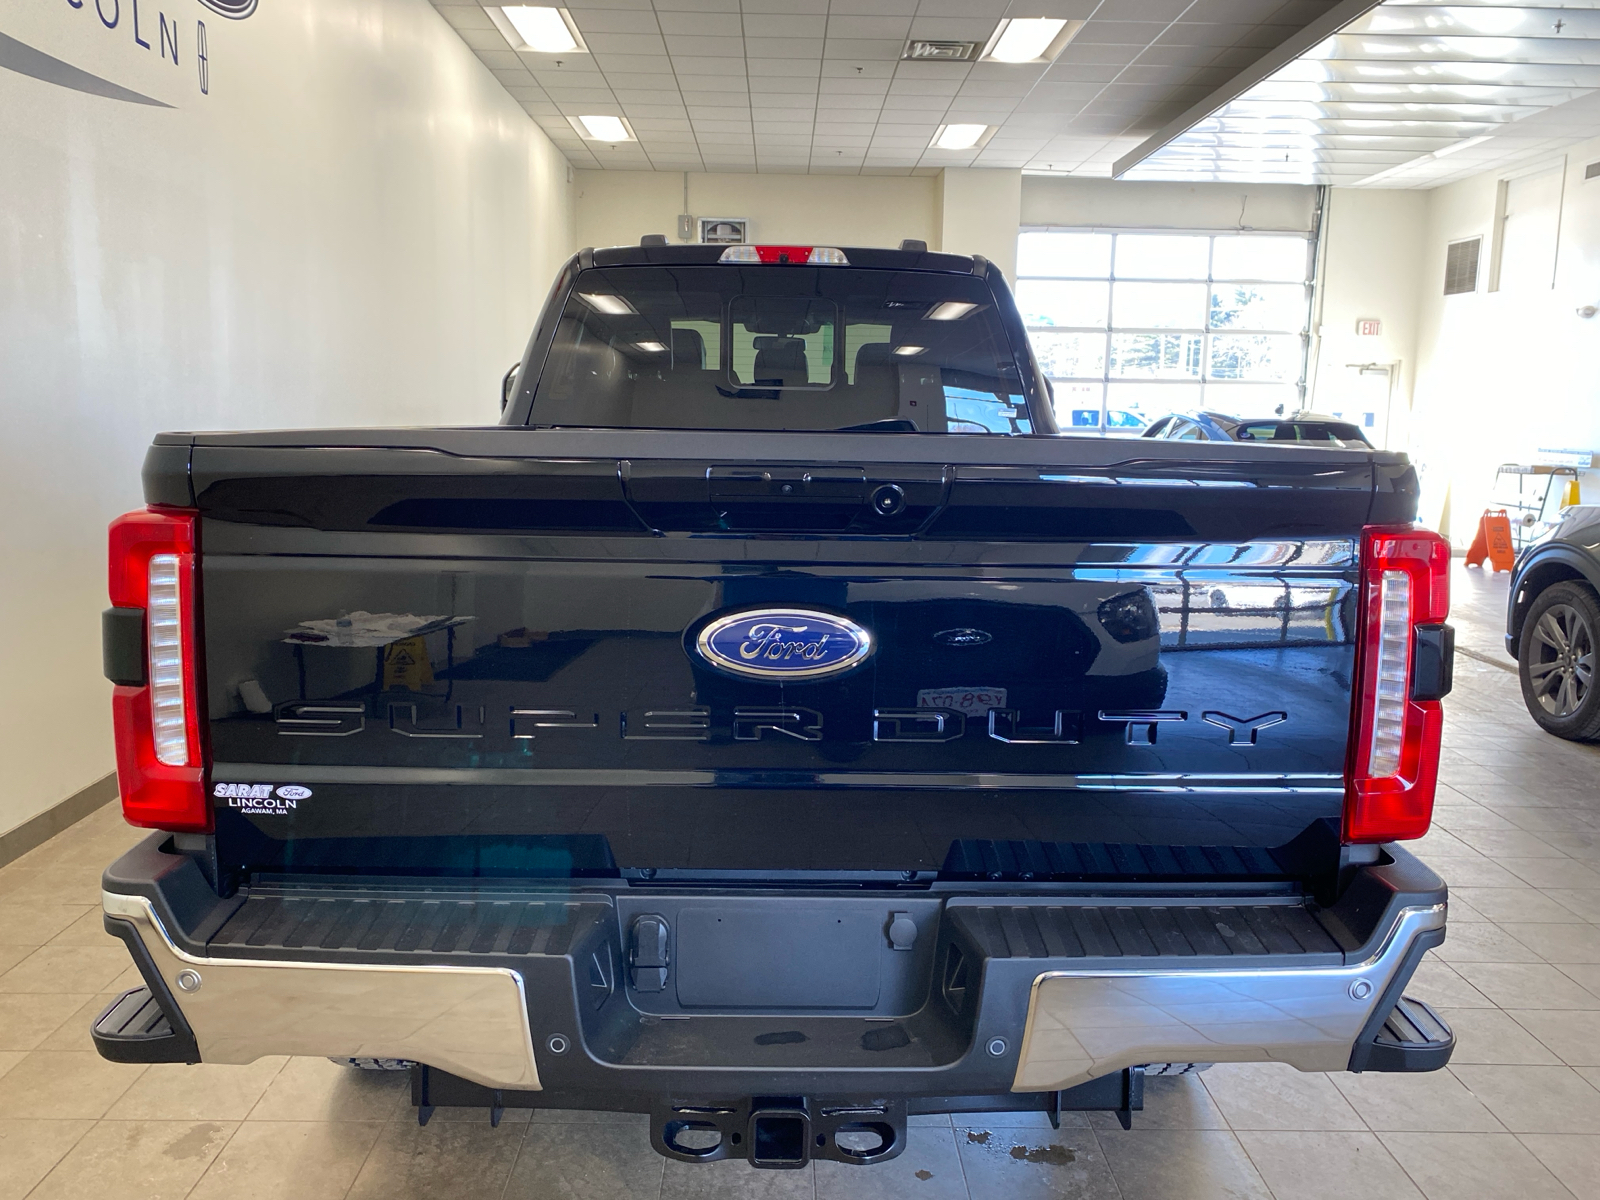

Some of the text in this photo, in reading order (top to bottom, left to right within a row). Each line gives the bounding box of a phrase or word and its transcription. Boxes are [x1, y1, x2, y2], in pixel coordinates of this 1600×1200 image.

[66, 0, 179, 66] OLN
[1362, 321, 1381, 336] EXIT
[739, 622, 830, 661] Ford
[274, 703, 1288, 746] SUPER DUTY
[213, 783, 305, 799] SARAT Ford
[228, 798, 297, 808] LINCOLN
